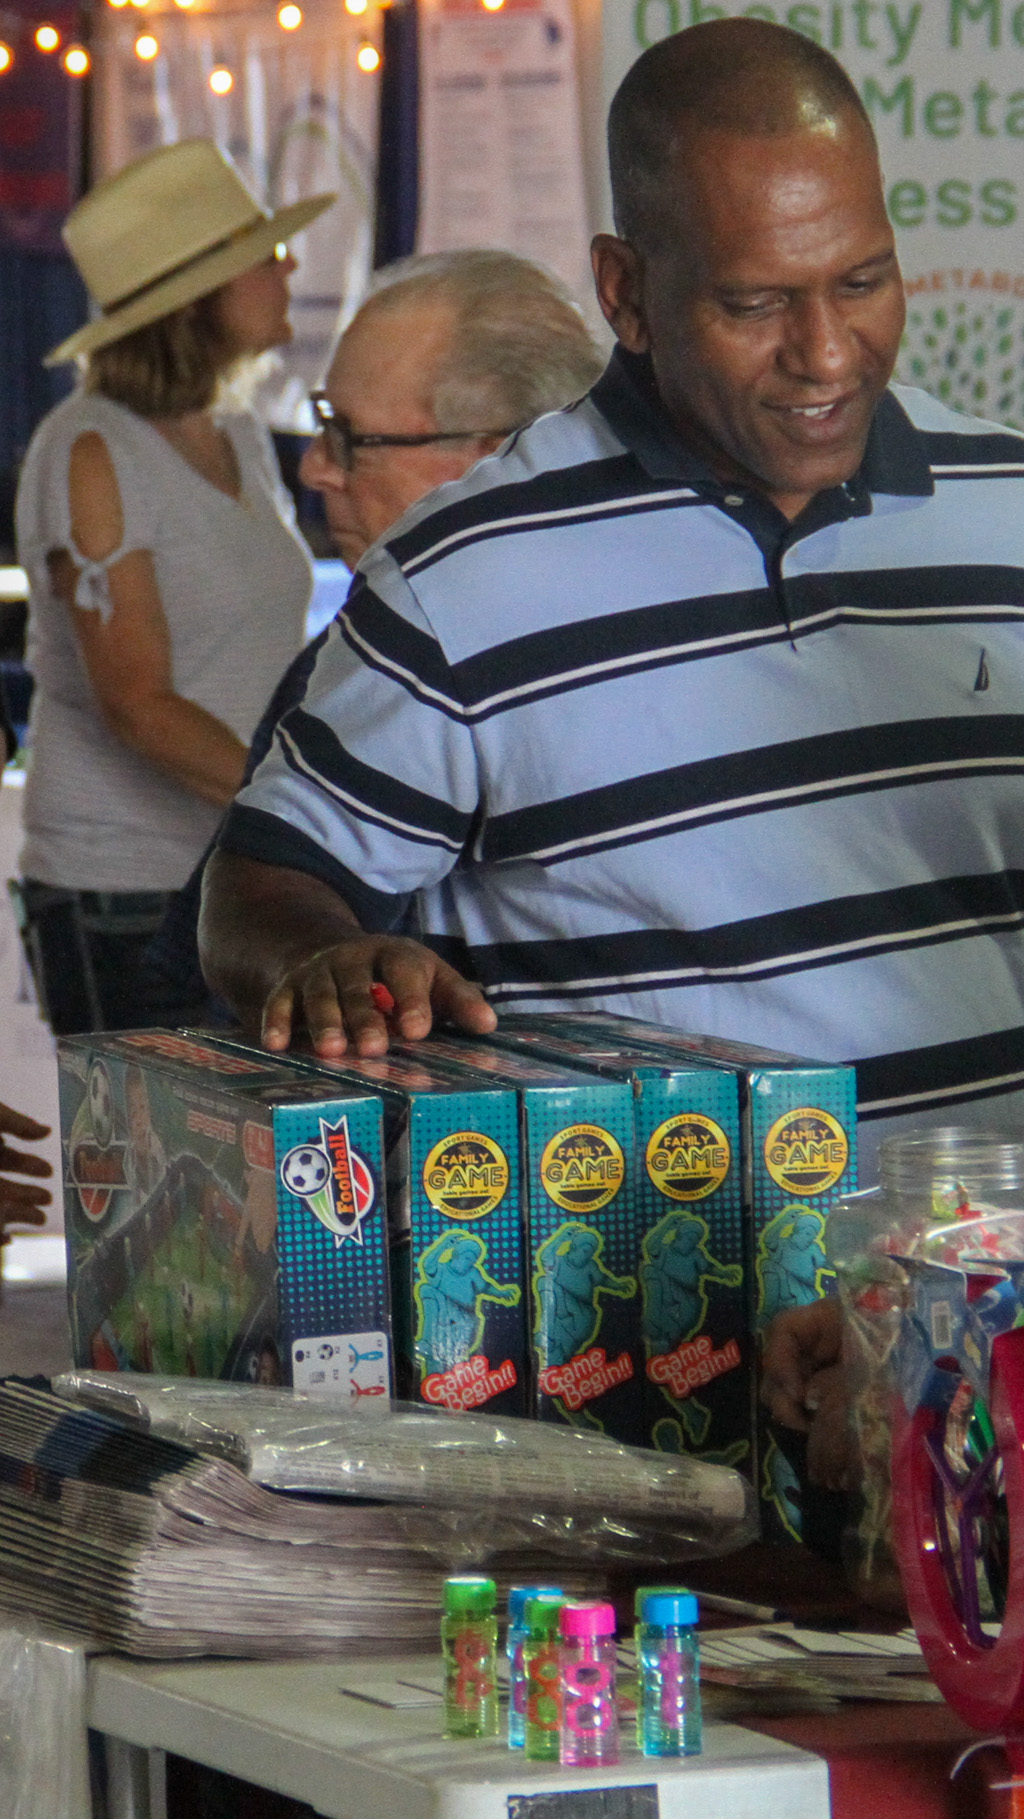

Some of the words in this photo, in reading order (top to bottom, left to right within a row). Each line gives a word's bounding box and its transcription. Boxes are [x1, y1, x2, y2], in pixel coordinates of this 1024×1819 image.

[888, 177, 1018, 228] ess
[443, 1136, 464, 1147] SPORT
[664, 1134, 711, 1147] FAMILY
[782, 1129, 829, 1140] FAMILY
[441, 1153, 489, 1165] FAMILY
[558, 1145, 605, 1158] FAMILY
[651, 1147, 726, 1172] GAME
[770, 1142, 844, 1166] GAME
[328, 1134, 354, 1214] Football
[428, 1166, 504, 1190] GAME
[546, 1159, 620, 1183] GAME
[481, 1196, 498, 1212] GAMES
[651, 1339, 709, 1381] Game
[670, 1347, 737, 1395] Begin!!
[426, 1359, 485, 1401] Game
[544, 1352, 601, 1393] Game
[560, 1358, 633, 1408] Begin!!
[445, 1365, 515, 1411] Begin!!
